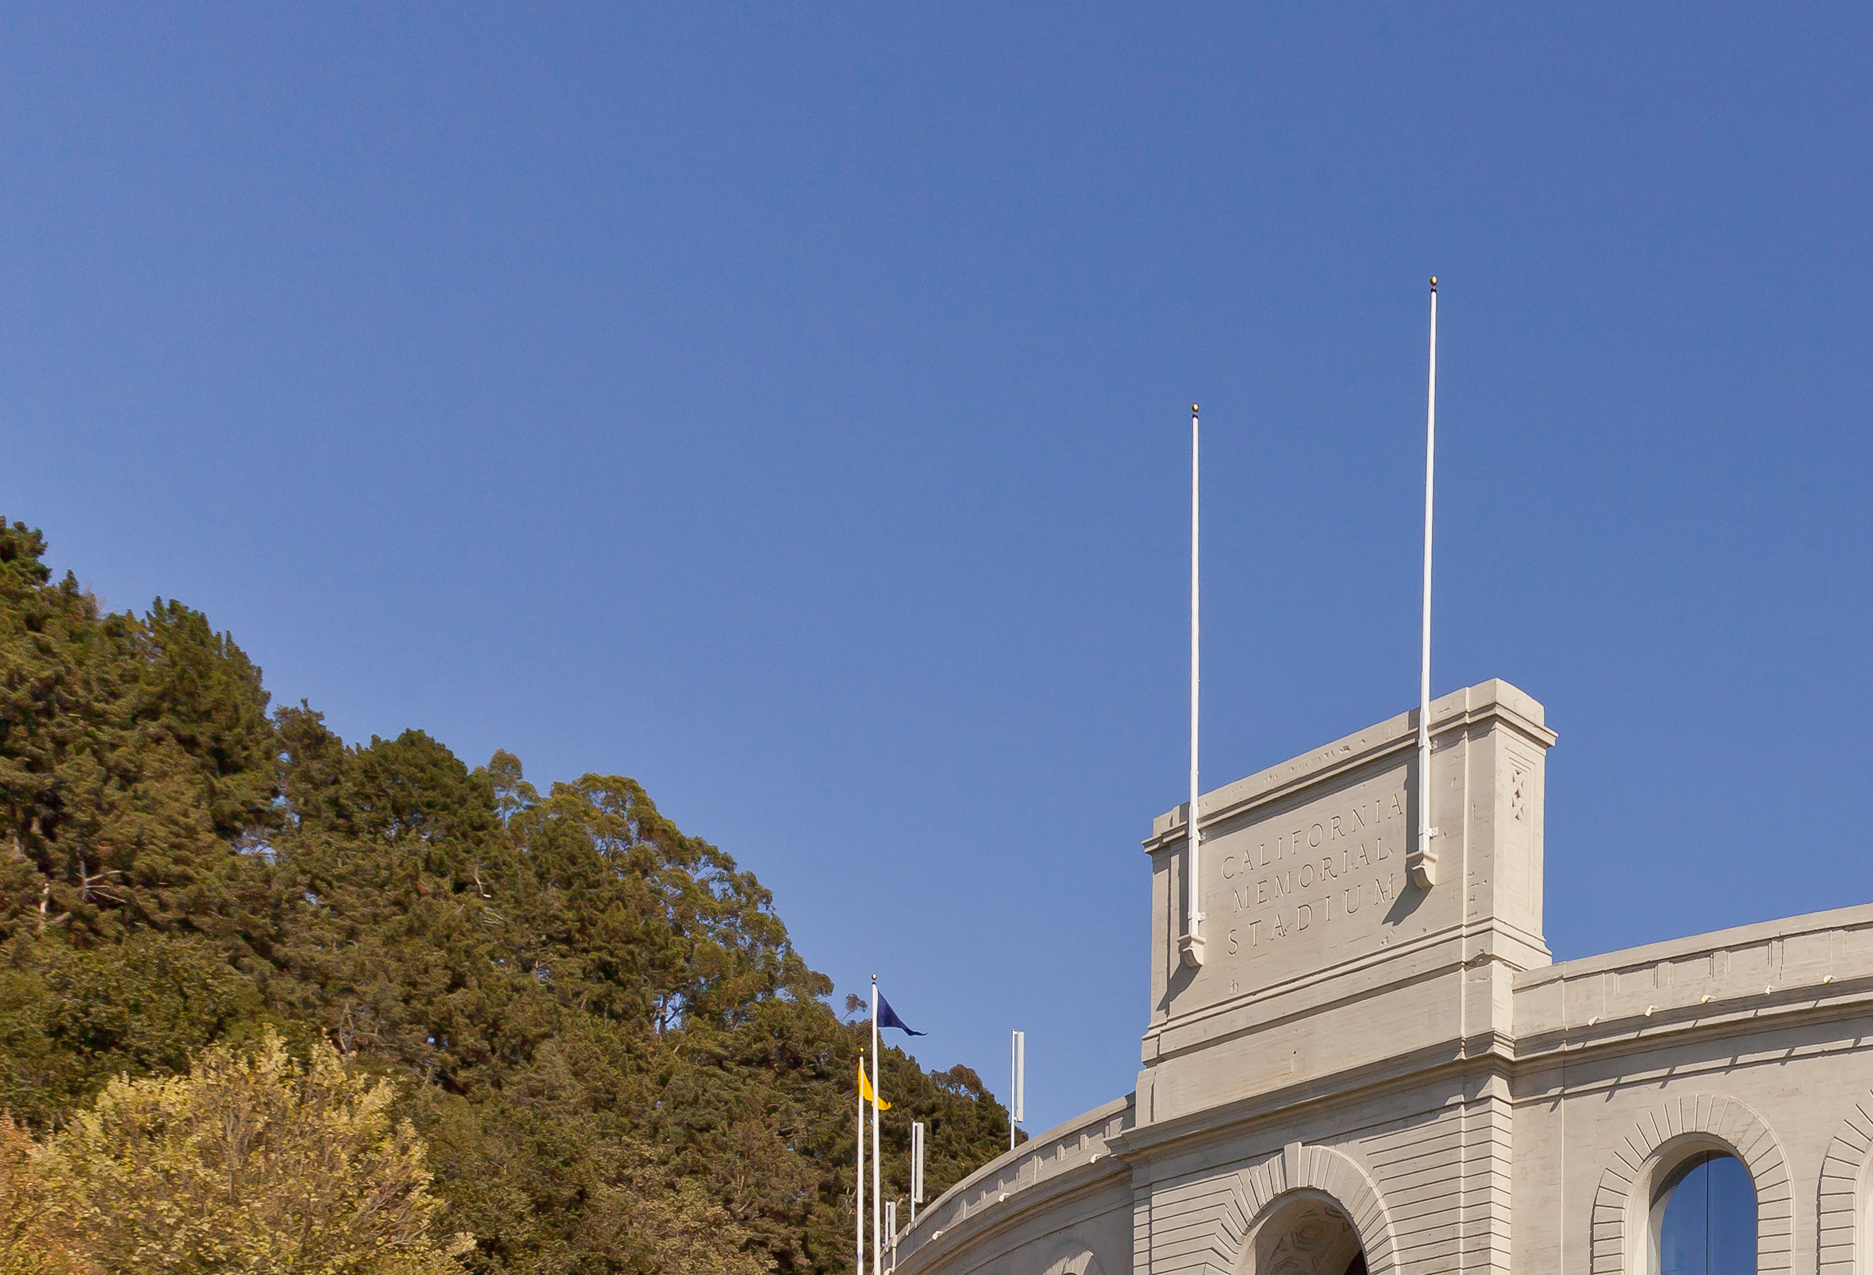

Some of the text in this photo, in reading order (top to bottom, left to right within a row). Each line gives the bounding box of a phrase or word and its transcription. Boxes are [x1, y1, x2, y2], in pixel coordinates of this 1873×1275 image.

[1221, 793, 1403, 880] CALIFORNIA
[1233, 837, 1390, 913] MEMORIAL
[1227, 873, 1395, 956] STADIUM
